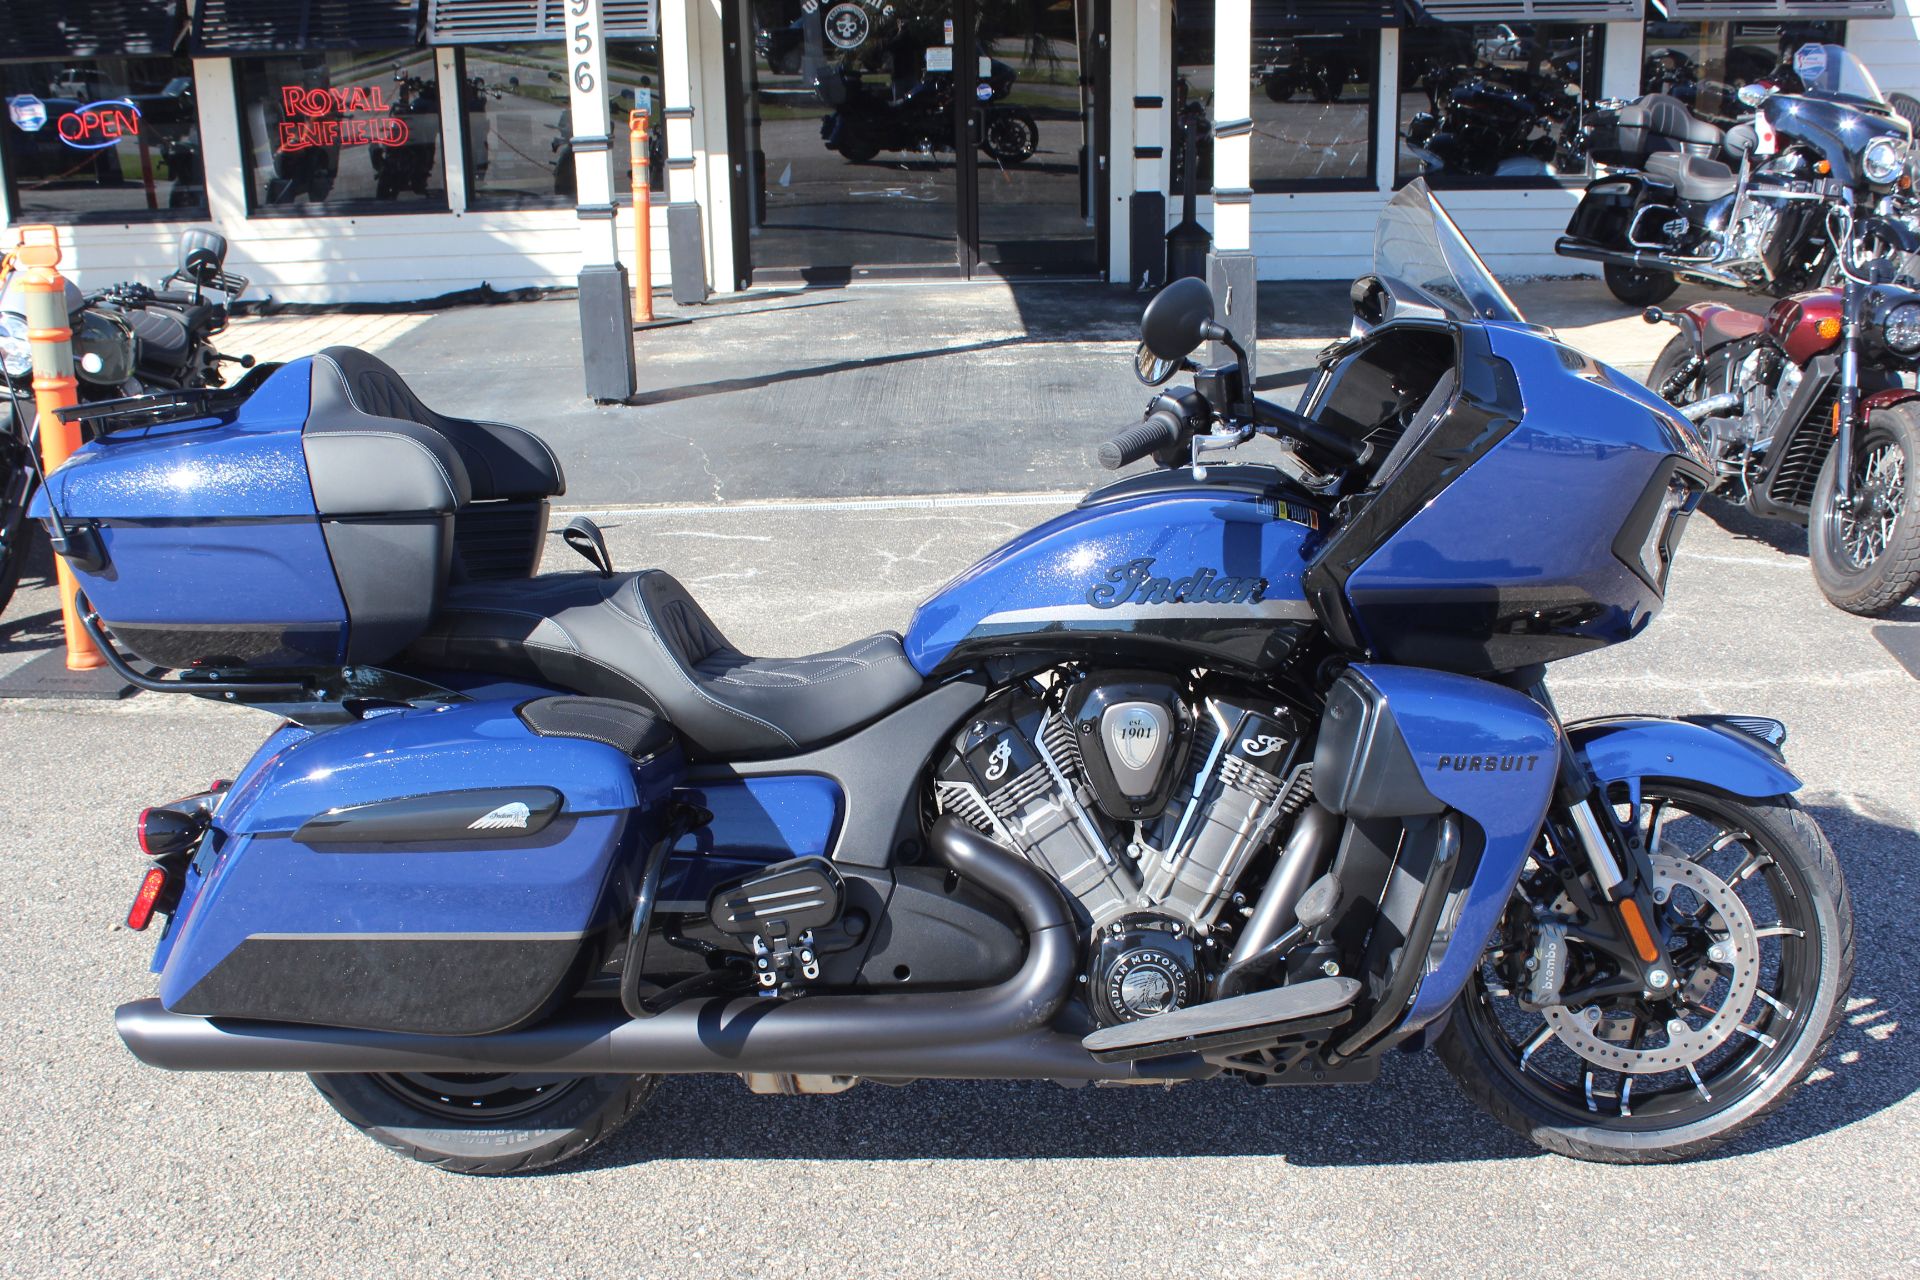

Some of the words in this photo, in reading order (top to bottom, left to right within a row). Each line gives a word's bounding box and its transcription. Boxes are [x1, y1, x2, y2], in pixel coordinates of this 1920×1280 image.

[282, 86, 389, 117] ROYAL
[58, 110, 139, 139] OPEN
[279, 118, 408, 151] ENFIELD
[1086, 557, 1268, 609] Indian
[1121, 727, 1151, 740] 1901
[1437, 755, 1539, 771] PURSUIT
[1542, 942, 1557, 990] brembo
[1111, 964, 1129, 1015] INDIAN
